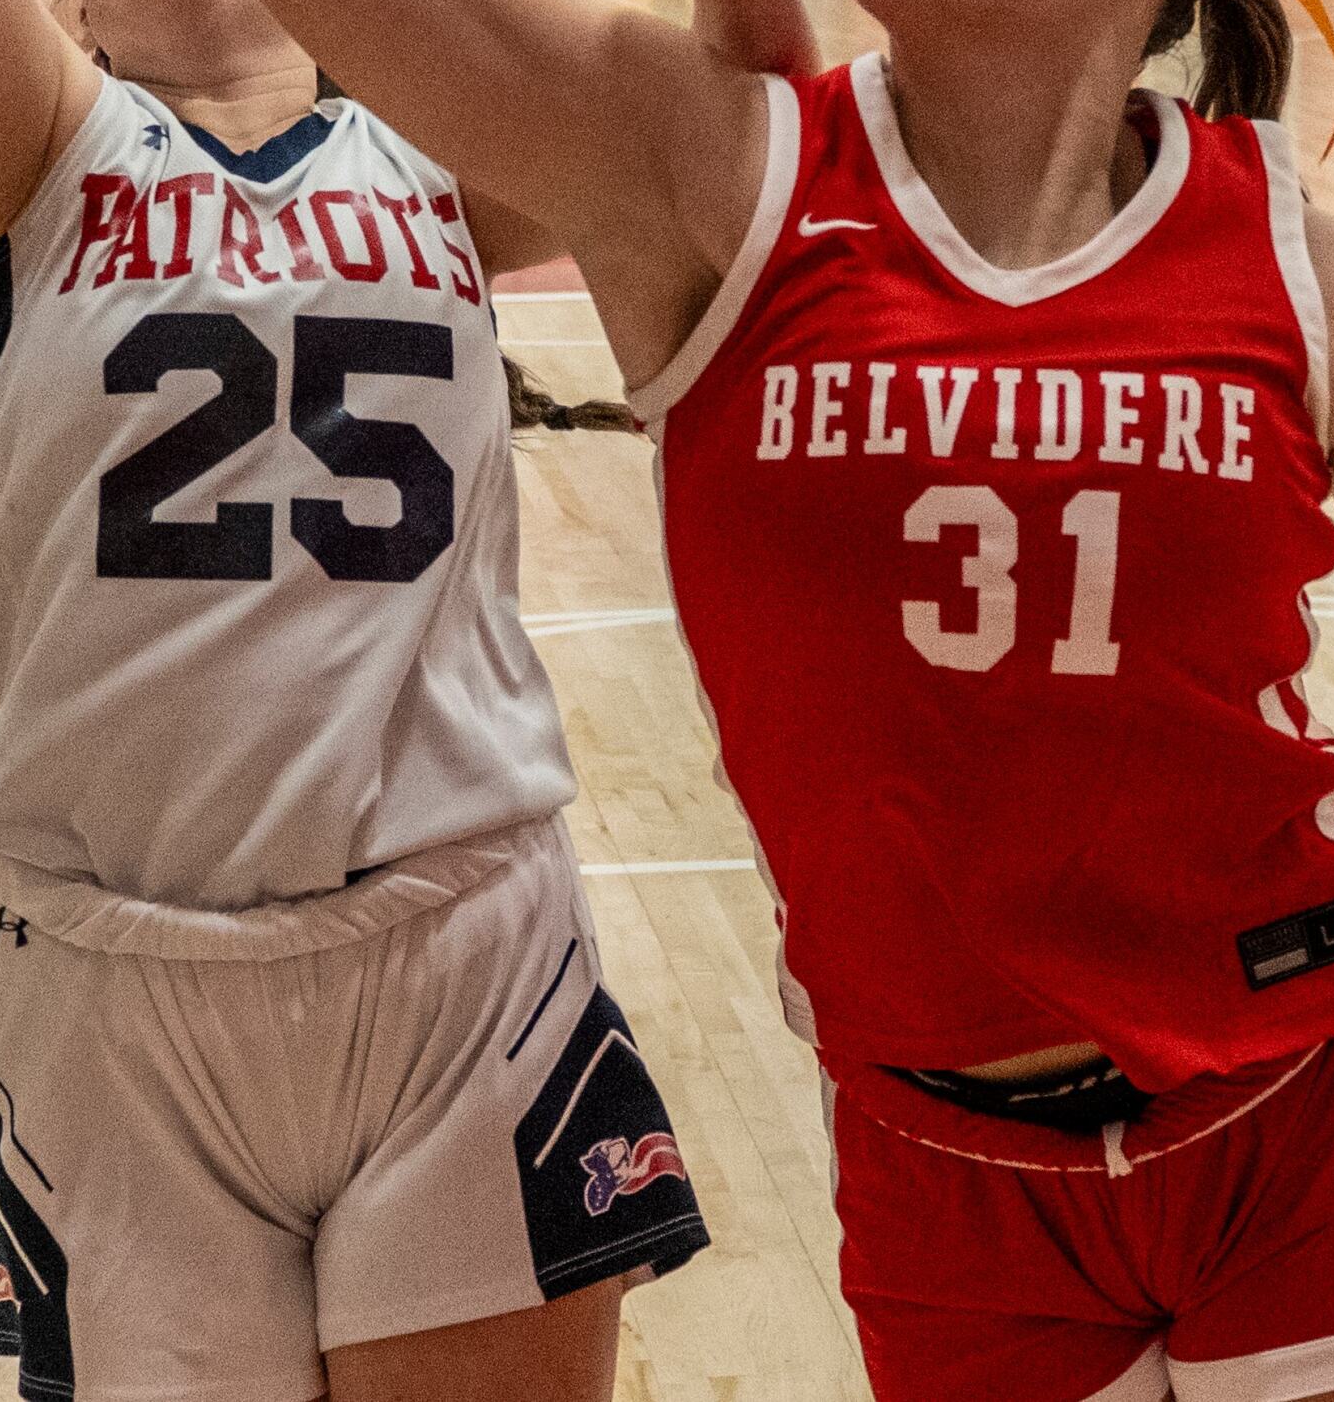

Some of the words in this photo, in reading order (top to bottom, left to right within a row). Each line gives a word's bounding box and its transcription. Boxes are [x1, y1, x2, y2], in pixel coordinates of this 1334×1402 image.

[57, 172, 481, 307] PATRIOTS
[95, 312, 455, 583] 25
[755, 360, 1256, 483] BELVIDERE
[901, 485, 1121, 677] 31
